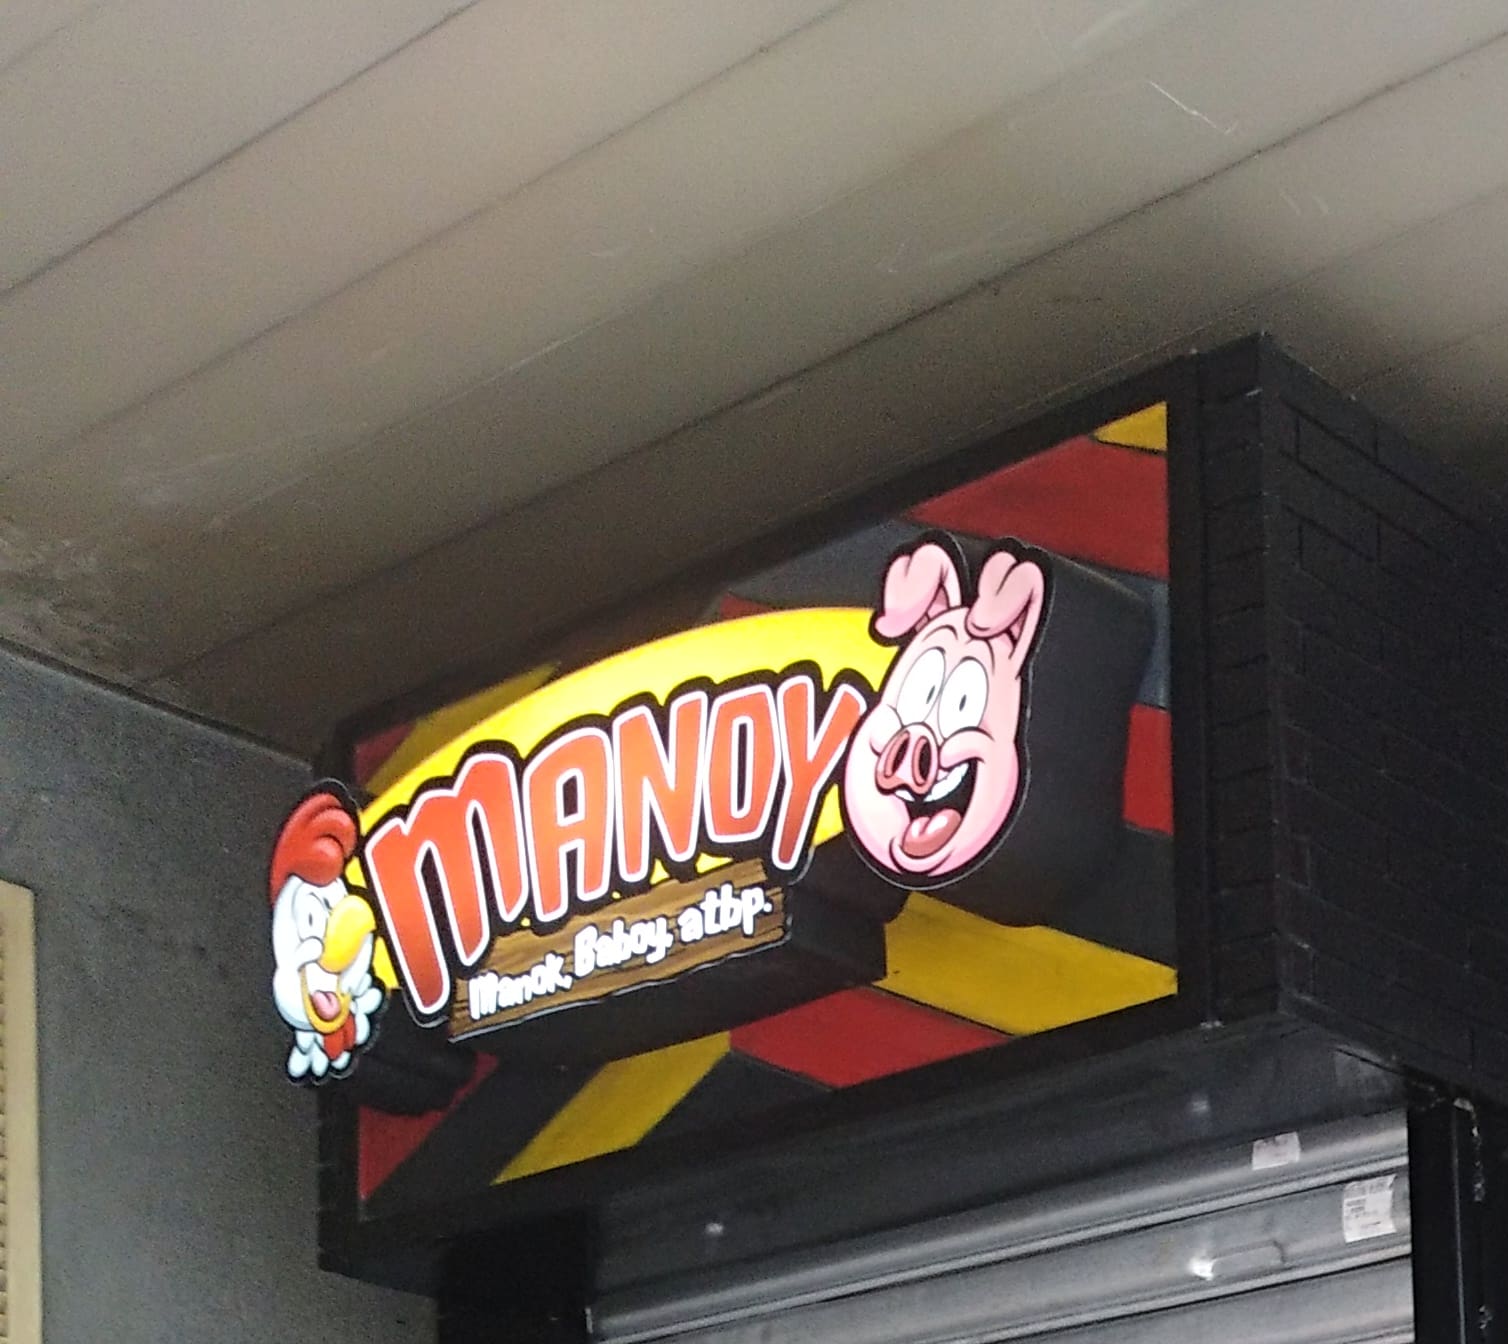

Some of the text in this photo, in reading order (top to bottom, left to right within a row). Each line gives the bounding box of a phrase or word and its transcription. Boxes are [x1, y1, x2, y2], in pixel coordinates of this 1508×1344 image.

[365, 674, 868, 1016] MANOY
[573, 917, 674, 978] Baboy,
[677, 883, 774, 943] atbp.
